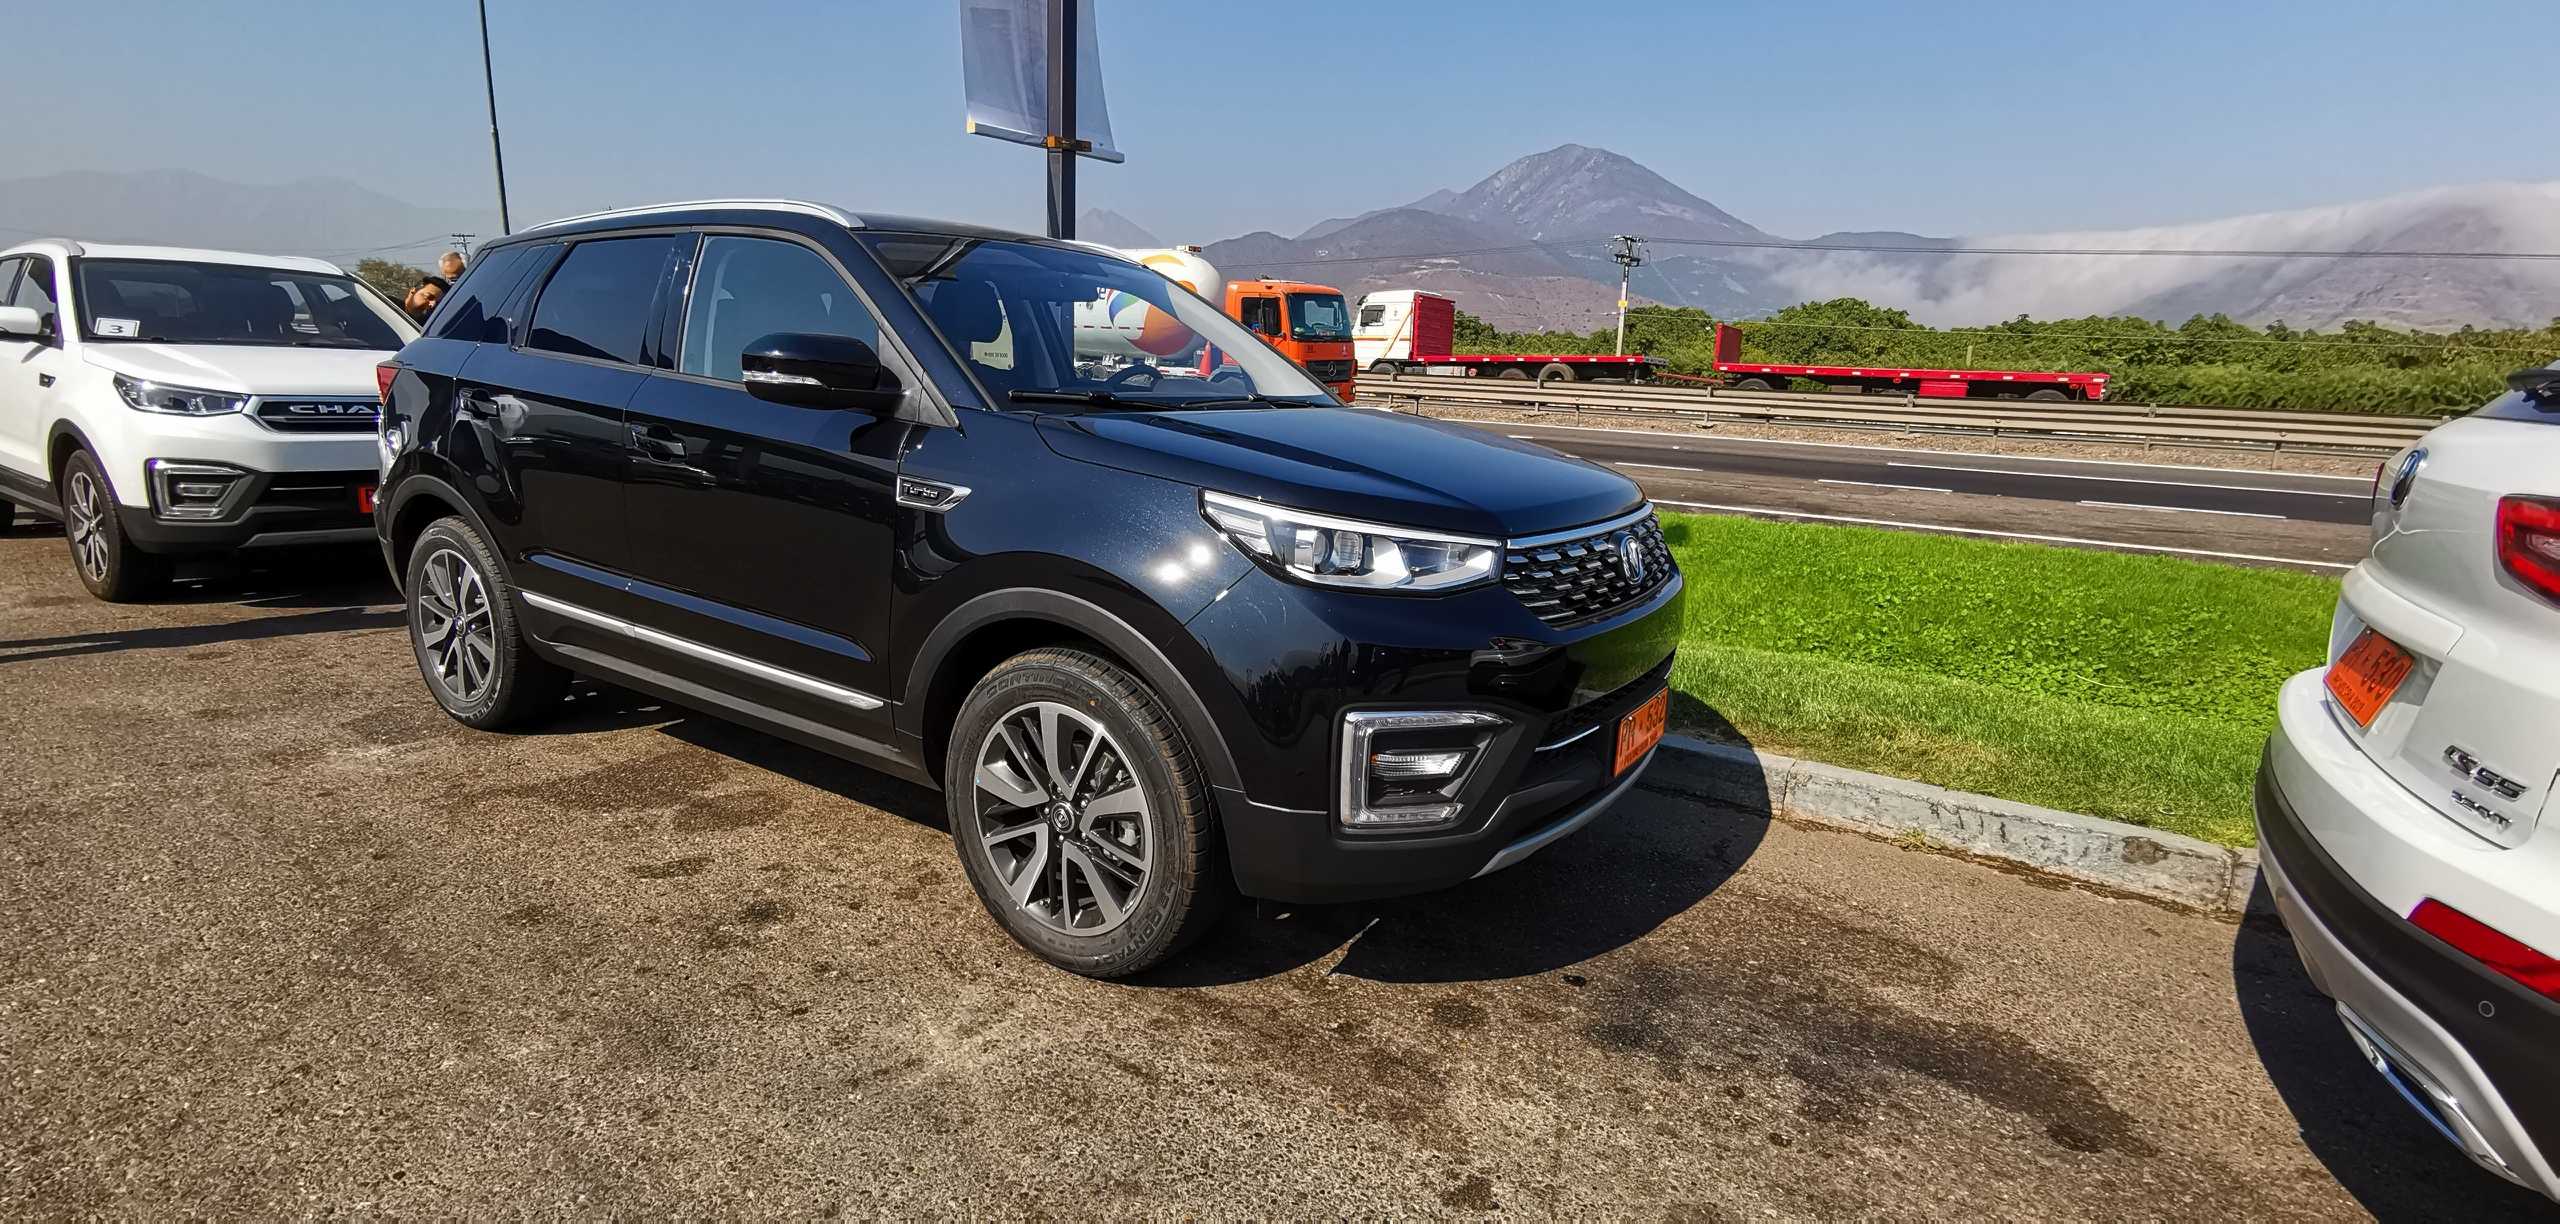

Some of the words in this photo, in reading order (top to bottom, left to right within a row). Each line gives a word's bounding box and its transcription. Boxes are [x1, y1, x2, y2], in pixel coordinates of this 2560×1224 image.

[109, 324, 123, 334] 3
[289, 404, 382, 414] CHA
[902, 483, 939, 499] Turbo
